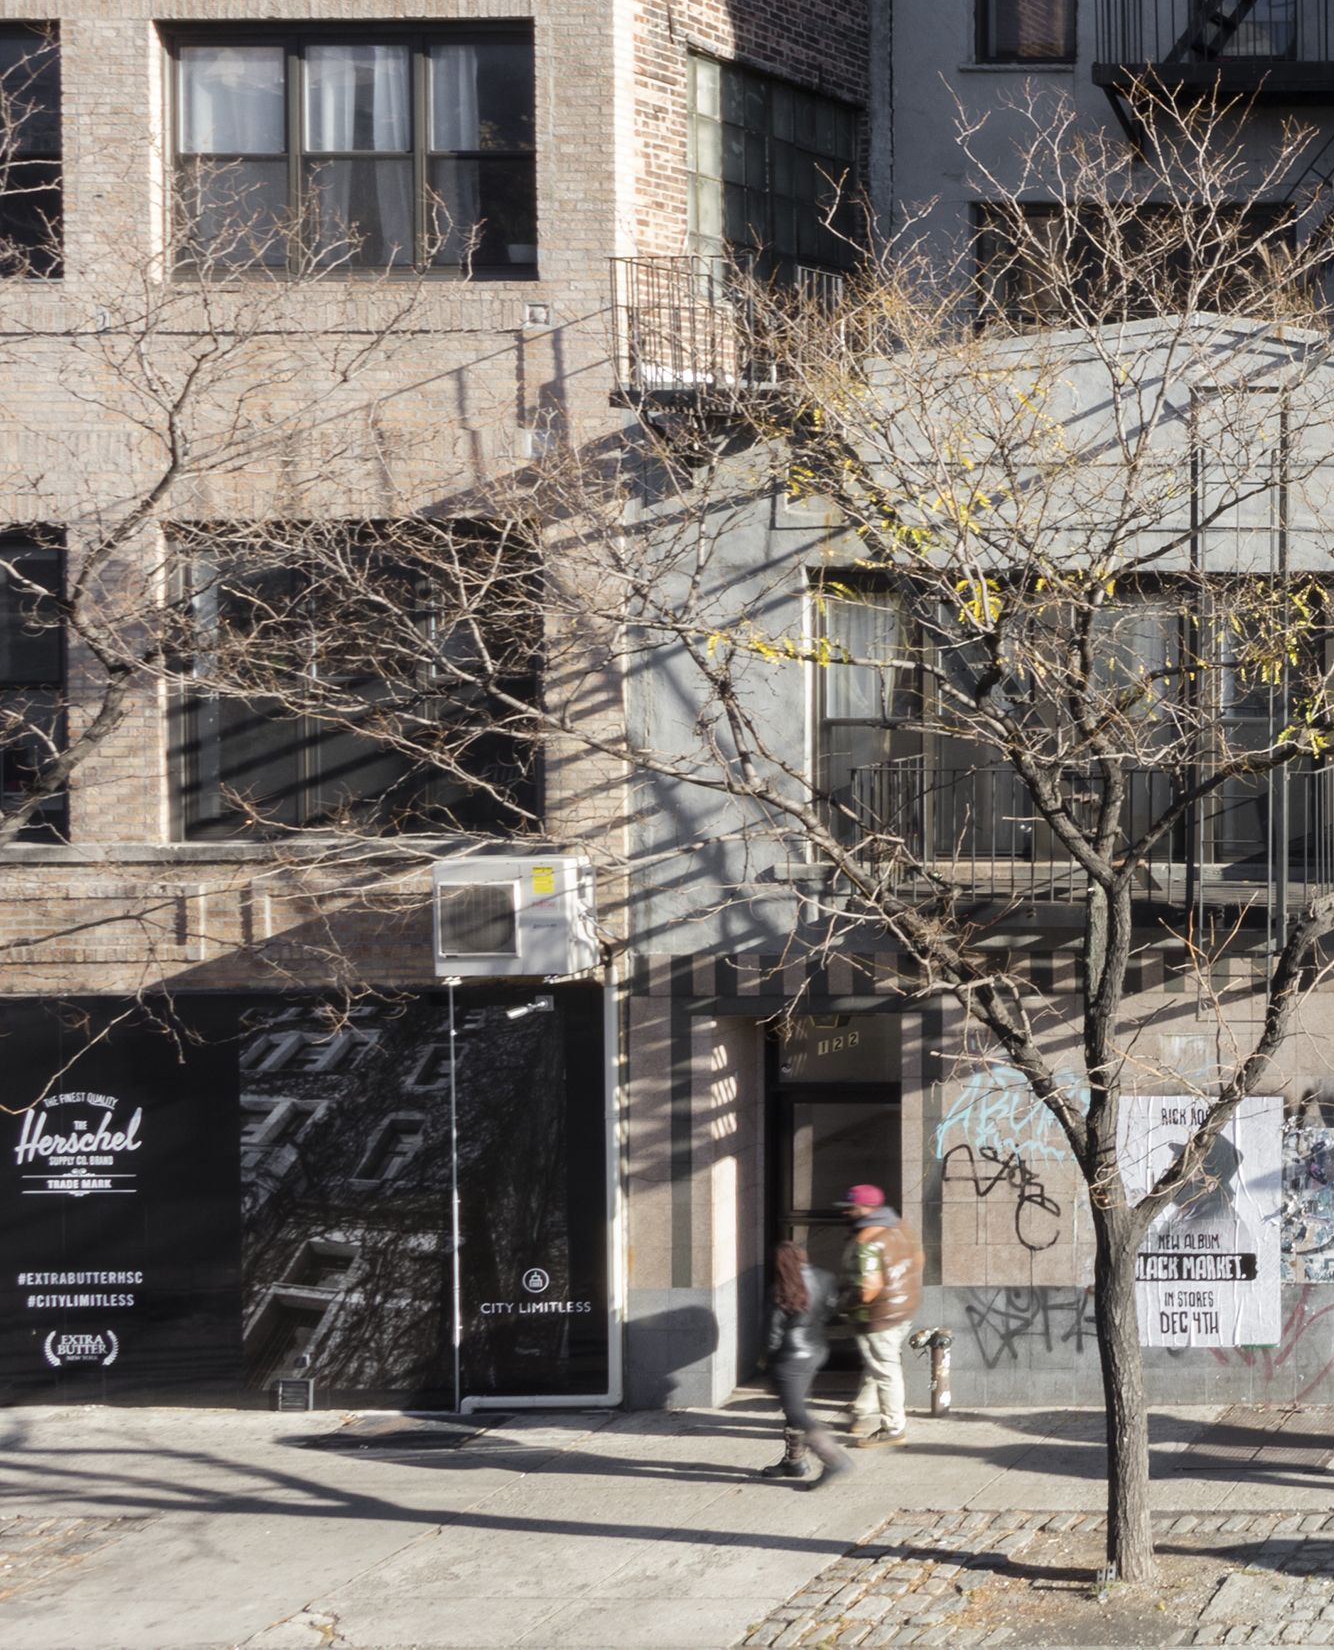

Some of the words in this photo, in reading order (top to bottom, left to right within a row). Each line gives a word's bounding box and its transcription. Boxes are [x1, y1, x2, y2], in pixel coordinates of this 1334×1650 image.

[819, 1032, 859, 1054] 122
[43, 1097, 60, 1108] THE
[59, 1092, 87, 1105] FINEST
[86, 1092, 119, 1110] QUALITY
[1161, 1107, 1187, 1126] RICK
[73, 1120, 88, 1131] THE
[14, 1107, 143, 1165] Herschel
[48, 1155, 75, 1166] SUPPLY
[89, 1155, 114, 1166] BRAND
[46, 1179, 80, 1189] TRADE
[80, 1178, 113, 1189] MARK
[1158, 1233, 1180, 1251] NEW
[1184, 1233, 1220, 1250] ALBUM
[1182, 1255, 1247, 1280] MARKET.
[17, 1271, 143, 1286] #EXTRABUTTERHSC
[27, 1294, 135, 1308] #CITYLIMITLESS
[480, 1302, 515, 1314] CITY
[518, 1301, 592, 1314] LIMITLESS
[1164, 1291, 1176, 1308] IN
[1178, 1291, 1214, 1308] STORES
[1160, 1311, 1189, 1335] DEC
[1192, 1311, 1220, 1335] 4TH
[61, 1334, 105, 1345] EXTRA
[56, 1344, 108, 1356] BUTTER
